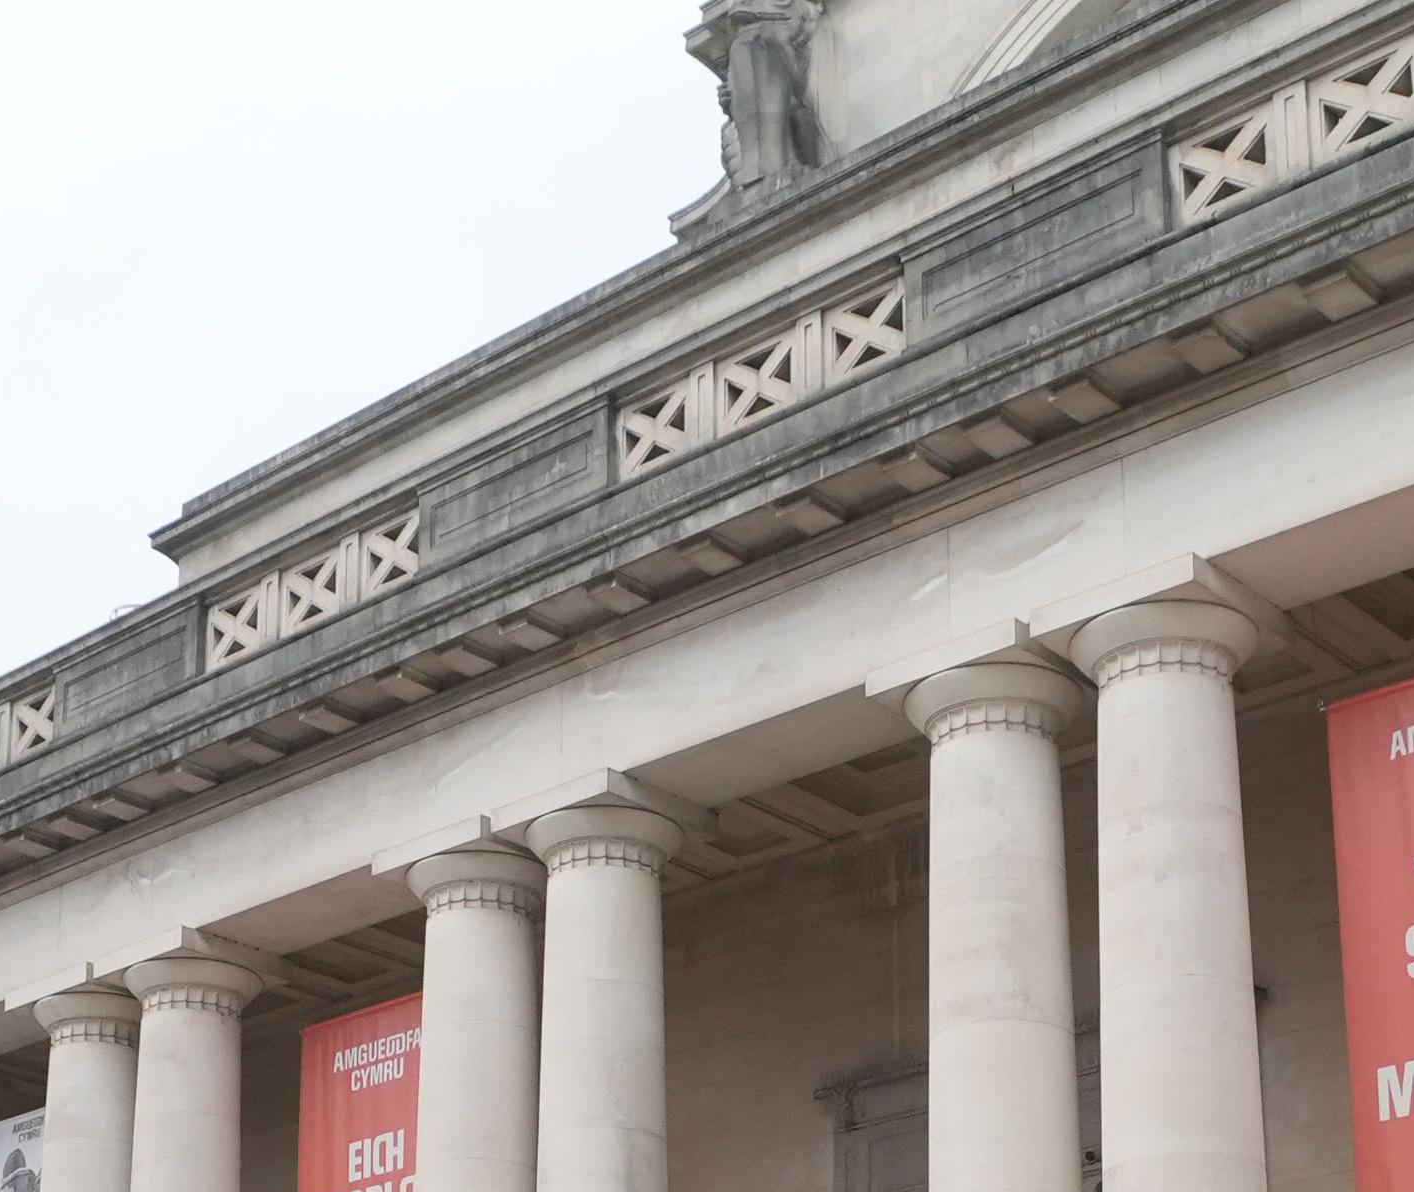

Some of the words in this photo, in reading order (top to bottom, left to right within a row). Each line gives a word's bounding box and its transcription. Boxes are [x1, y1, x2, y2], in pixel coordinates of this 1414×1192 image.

[333, 1027, 421, 1073] AMGUEDDFA
[351, 1057, 404, 1092] CYMRU
[348, 1128, 404, 1183] EICH
